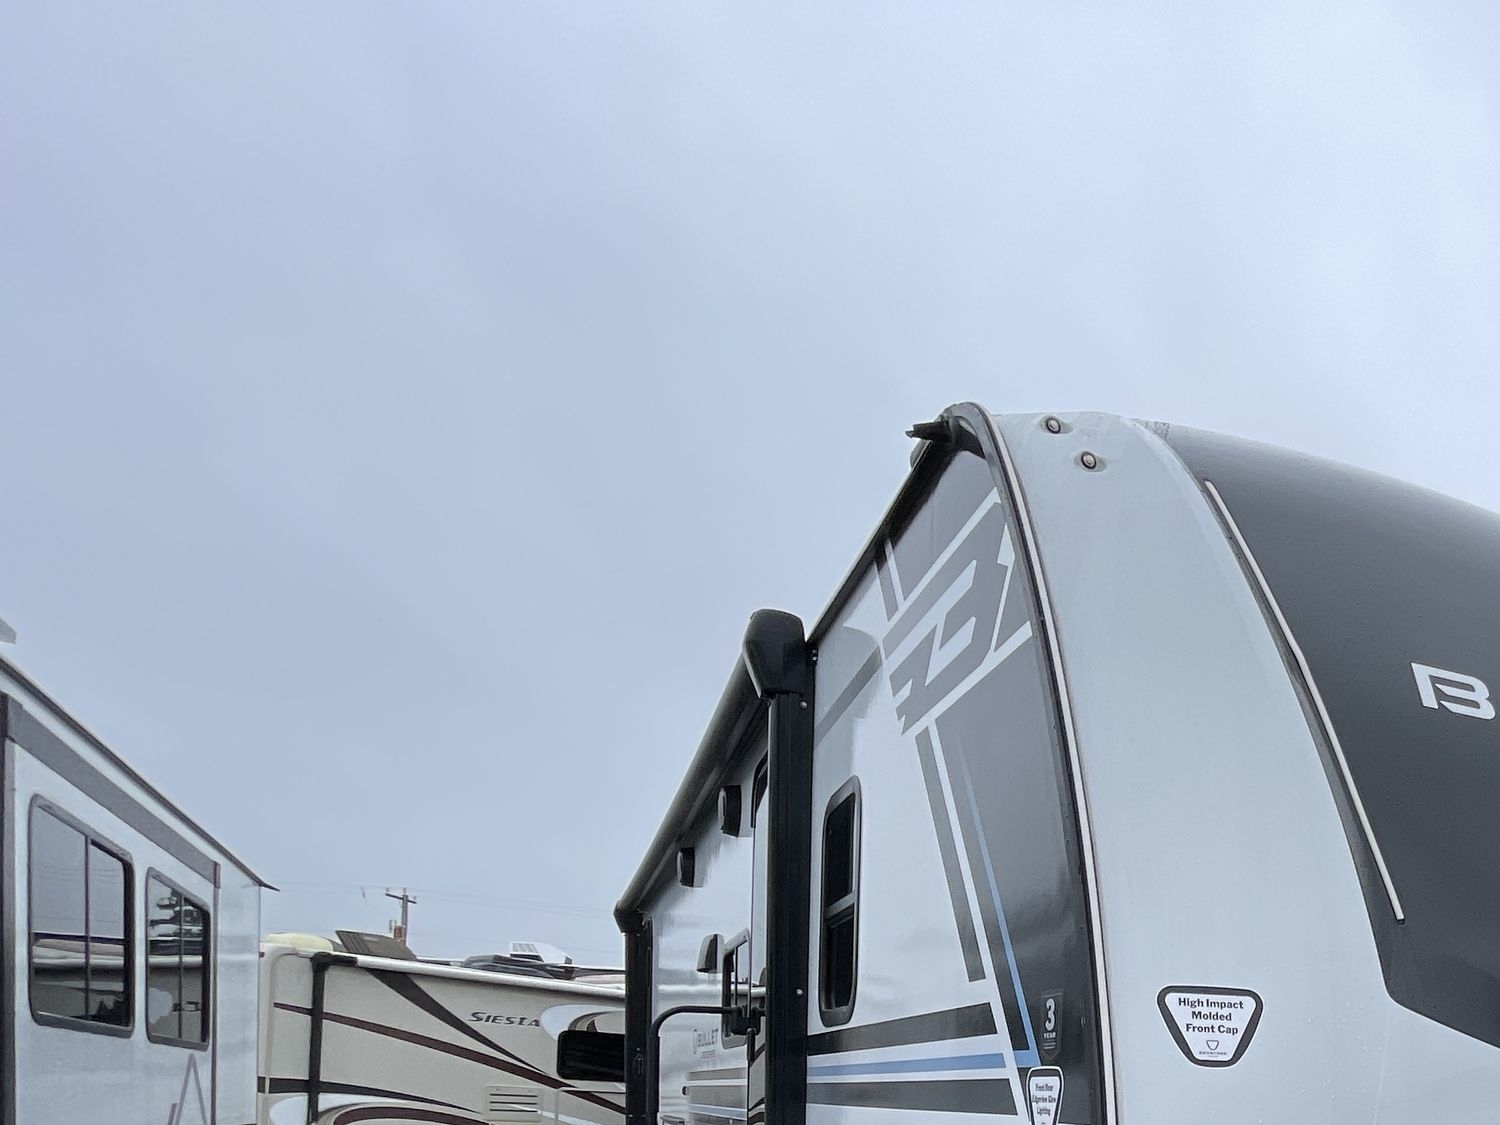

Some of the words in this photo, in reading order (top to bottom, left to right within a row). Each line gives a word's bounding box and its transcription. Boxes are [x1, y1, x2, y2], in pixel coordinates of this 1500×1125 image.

[1178, 997, 1204, 1009] High
[1206, 998, 1244, 1010] Impact
[1044, 998, 1056, 1031] 3
[1191, 1010, 1232, 1021] Molded
[1186, 1023, 1216, 1033] Front
[1217, 1024, 1239, 1036] Cap
